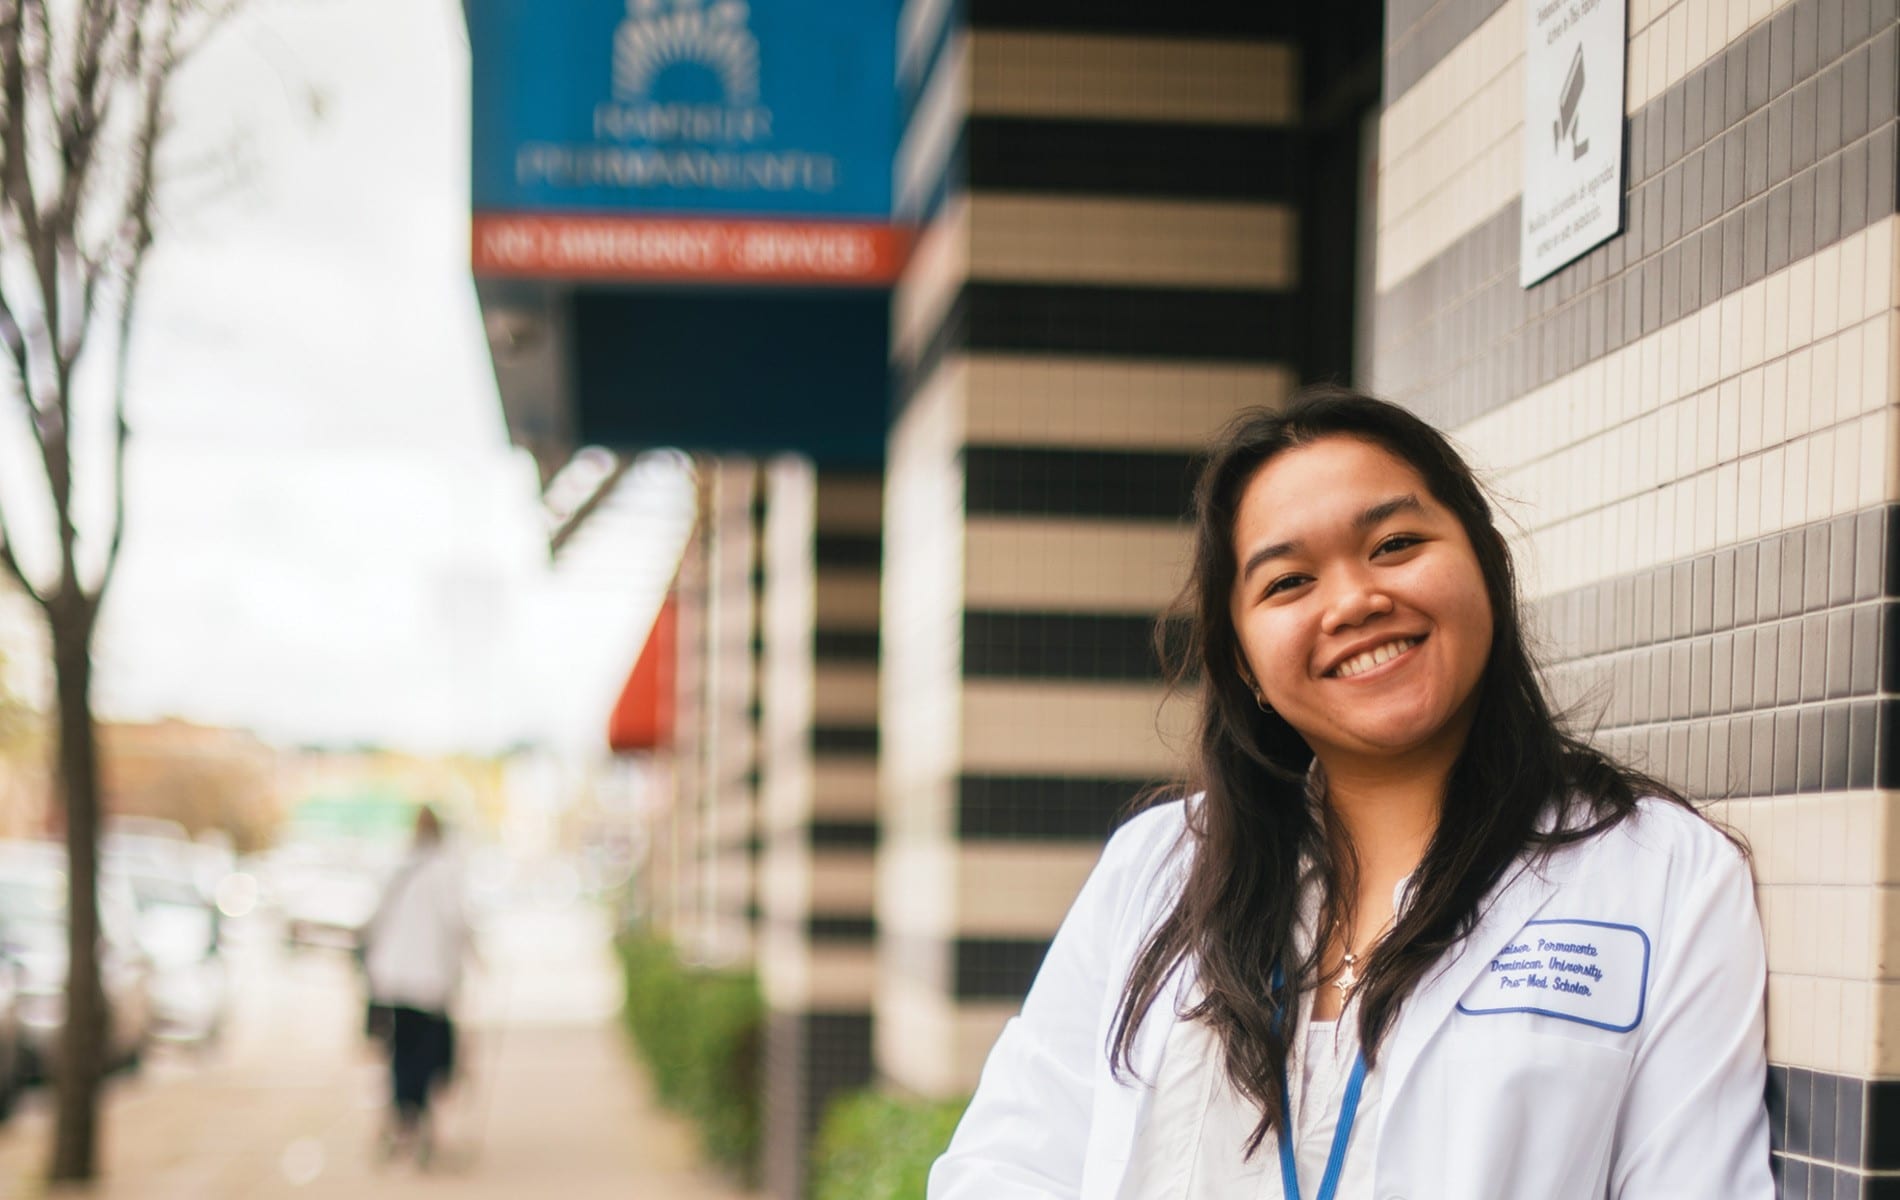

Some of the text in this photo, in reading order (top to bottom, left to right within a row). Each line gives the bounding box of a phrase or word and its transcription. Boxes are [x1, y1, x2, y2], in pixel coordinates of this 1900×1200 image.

[1537, 938, 1598, 957] Permanente
[1490, 956, 1603, 982] Dominican University
[1500, 973, 1592, 996] Pre-Med Scholar
